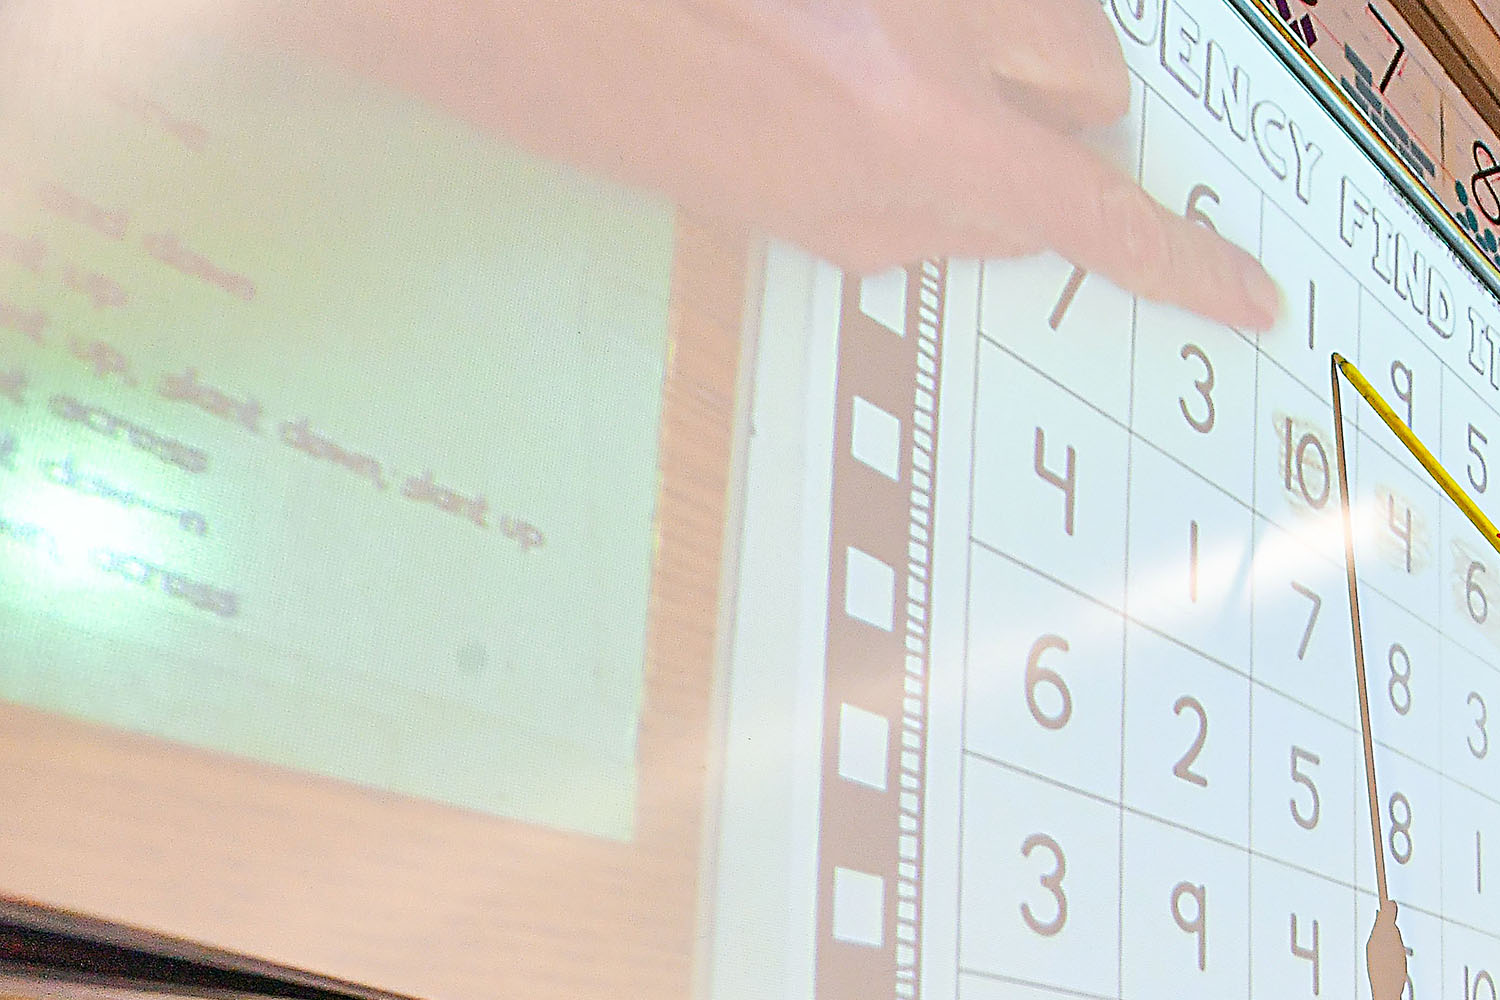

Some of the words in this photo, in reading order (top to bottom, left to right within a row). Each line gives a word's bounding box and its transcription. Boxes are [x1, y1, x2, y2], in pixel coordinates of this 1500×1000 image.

[1367, 2, 1405, 94] 7
[1340, 176, 1456, 339] FIND
[1178, 342, 1215, 434] 3
[1285, 416, 1331, 510] 10
[1388, 493, 1412, 574] 4
[1466, 561, 1488, 625] 6
[1309, 279, 1316, 350] 1
[1390, 360, 1413, 430] 9
[1467, 422, 1488, 494] 5
[1033, 426, 1076, 536] 4
[1190, 520, 1198, 603] 1
[1291, 580, 1322, 661] 7
[1387, 643, 1412, 717] 8
[1466, 691, 1489, 759] 3
[1024, 634, 1073, 731] 6
[1173, 696, 1209, 788] 2
[1289, 746, 1321, 831] 5
[1388, 792, 1413, 865] 8
[1475, 830, 1483, 895] 1
[1020, 833, 1069, 937] 3
[1170, 881, 1207, 971] 9
[1289, 912, 1321, 997] 4
